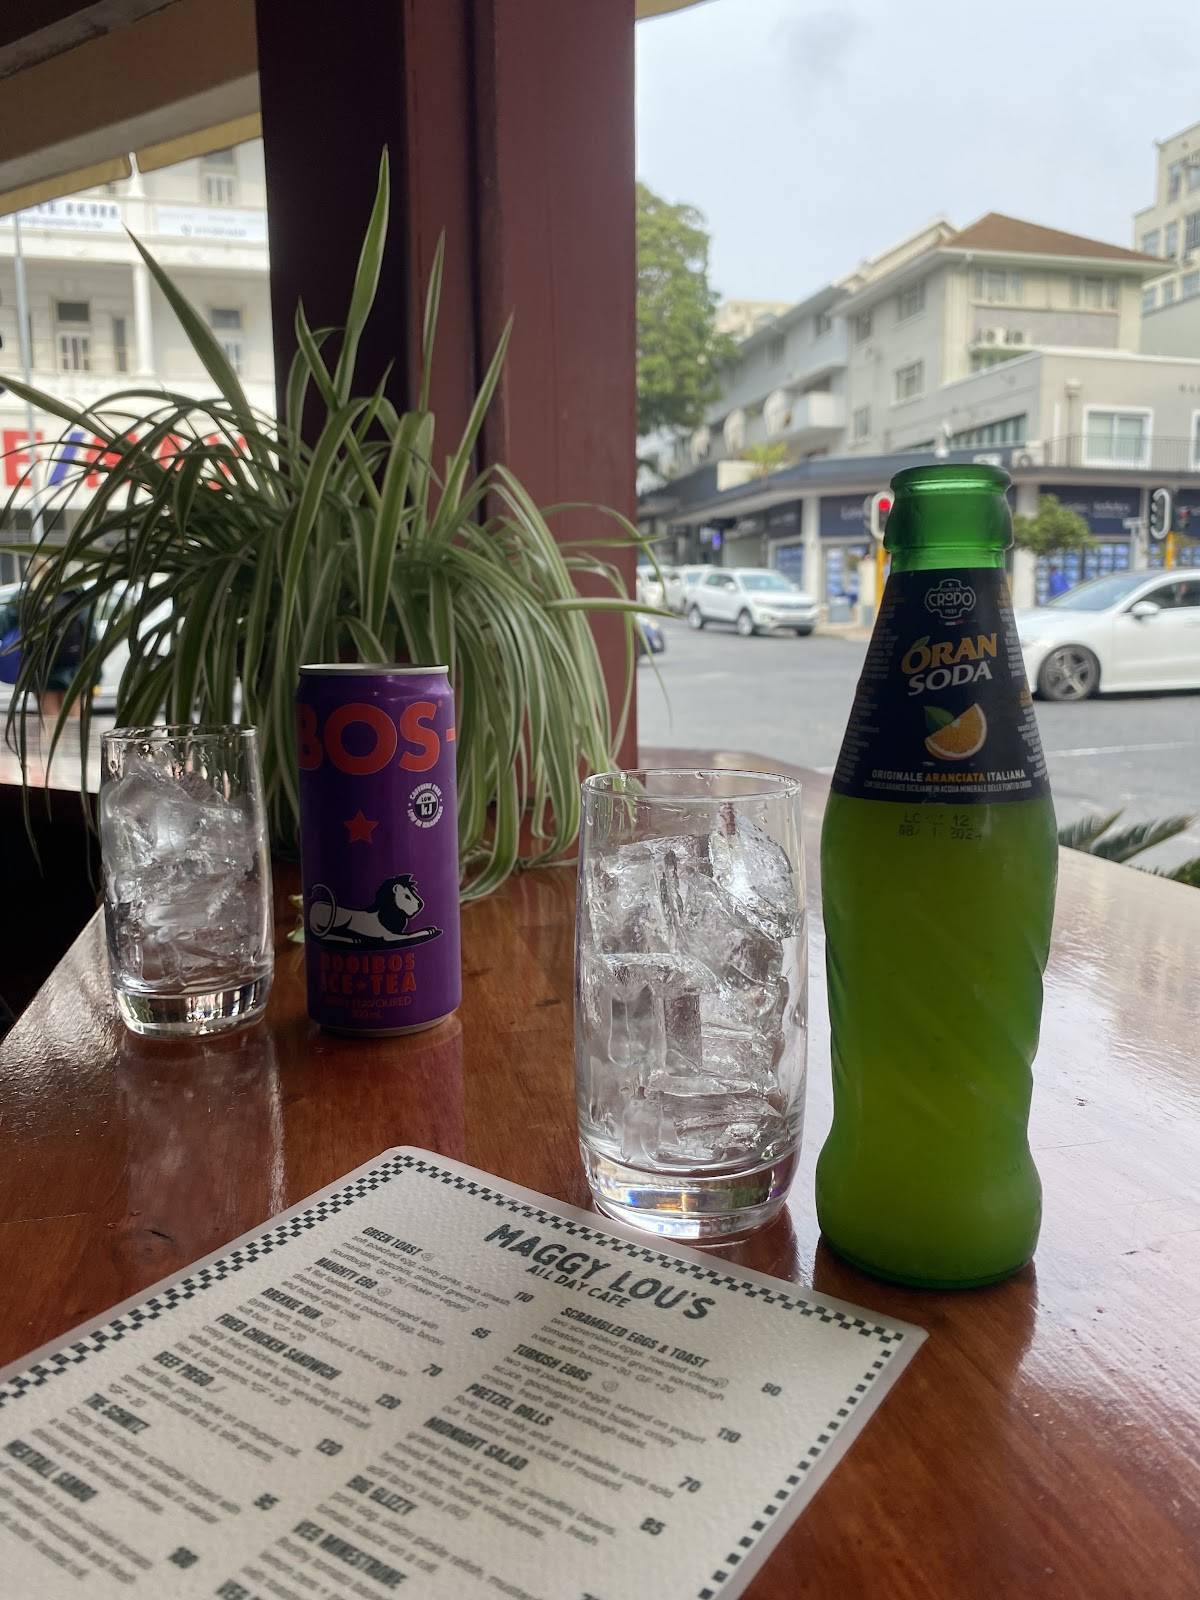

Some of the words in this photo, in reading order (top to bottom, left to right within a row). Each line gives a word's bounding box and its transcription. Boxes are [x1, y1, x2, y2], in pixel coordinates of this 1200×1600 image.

[929, 593, 972, 606] CRODO
[908, 660, 993, 696] SODA
[296, 701, 440, 775] BOS
[872, 769, 923, 782] ORIGINALE
[925, 774, 985, 783] ARANCIATA
[987, 769, 1026, 780] ITALIANA
[319, 952, 416, 974] ROOIBOS
[319, 971, 353, 994] ICE
[370, 970, 417, 995] TEA
[362, 1227, 394, 1244] GREEN
[391, 1239, 423, 1256] TOAST
[315, 1257, 360, 1280] NAUGHTY
[354, 1276, 378, 1289] EGG
[486, 1225, 610, 1279] MAGGY
[609, 1271, 715, 1319] LOU'S
[525, 1265, 554, 1280] ALL
[554, 1275, 589, 1291] DAY
[587, 1288, 631, 1308] CAFE
[261, 1288, 303, 1310] BREKKIE
[297, 1305, 323, 1320] BUN
[216, 1313, 248, 1332] FRIED
[243, 1328, 289, 1353] CHICKEN
[283, 1348, 341, 1380] SANDWICH
[561, 1308, 628, 1337] SCRAMBLED
[627, 1332, 659, 1349] EGGS
[657, 1345, 669, 1354] &
[670, 1348, 709, 1368] TOAST
[422, 1363, 443, 1377] 70
[514, 1344, 561, 1369] TURKISH
[558, 1363, 592, 1381] EGGS
[466, 1384, 514, 1410] PRETZEL
[513, 1404, 554, 1426] ROLLS
[424, 1417, 487, 1450] MIDNIGHT
[484, 1445, 528, 1471] SALAD
[678, 1476, 701, 1493] 70
